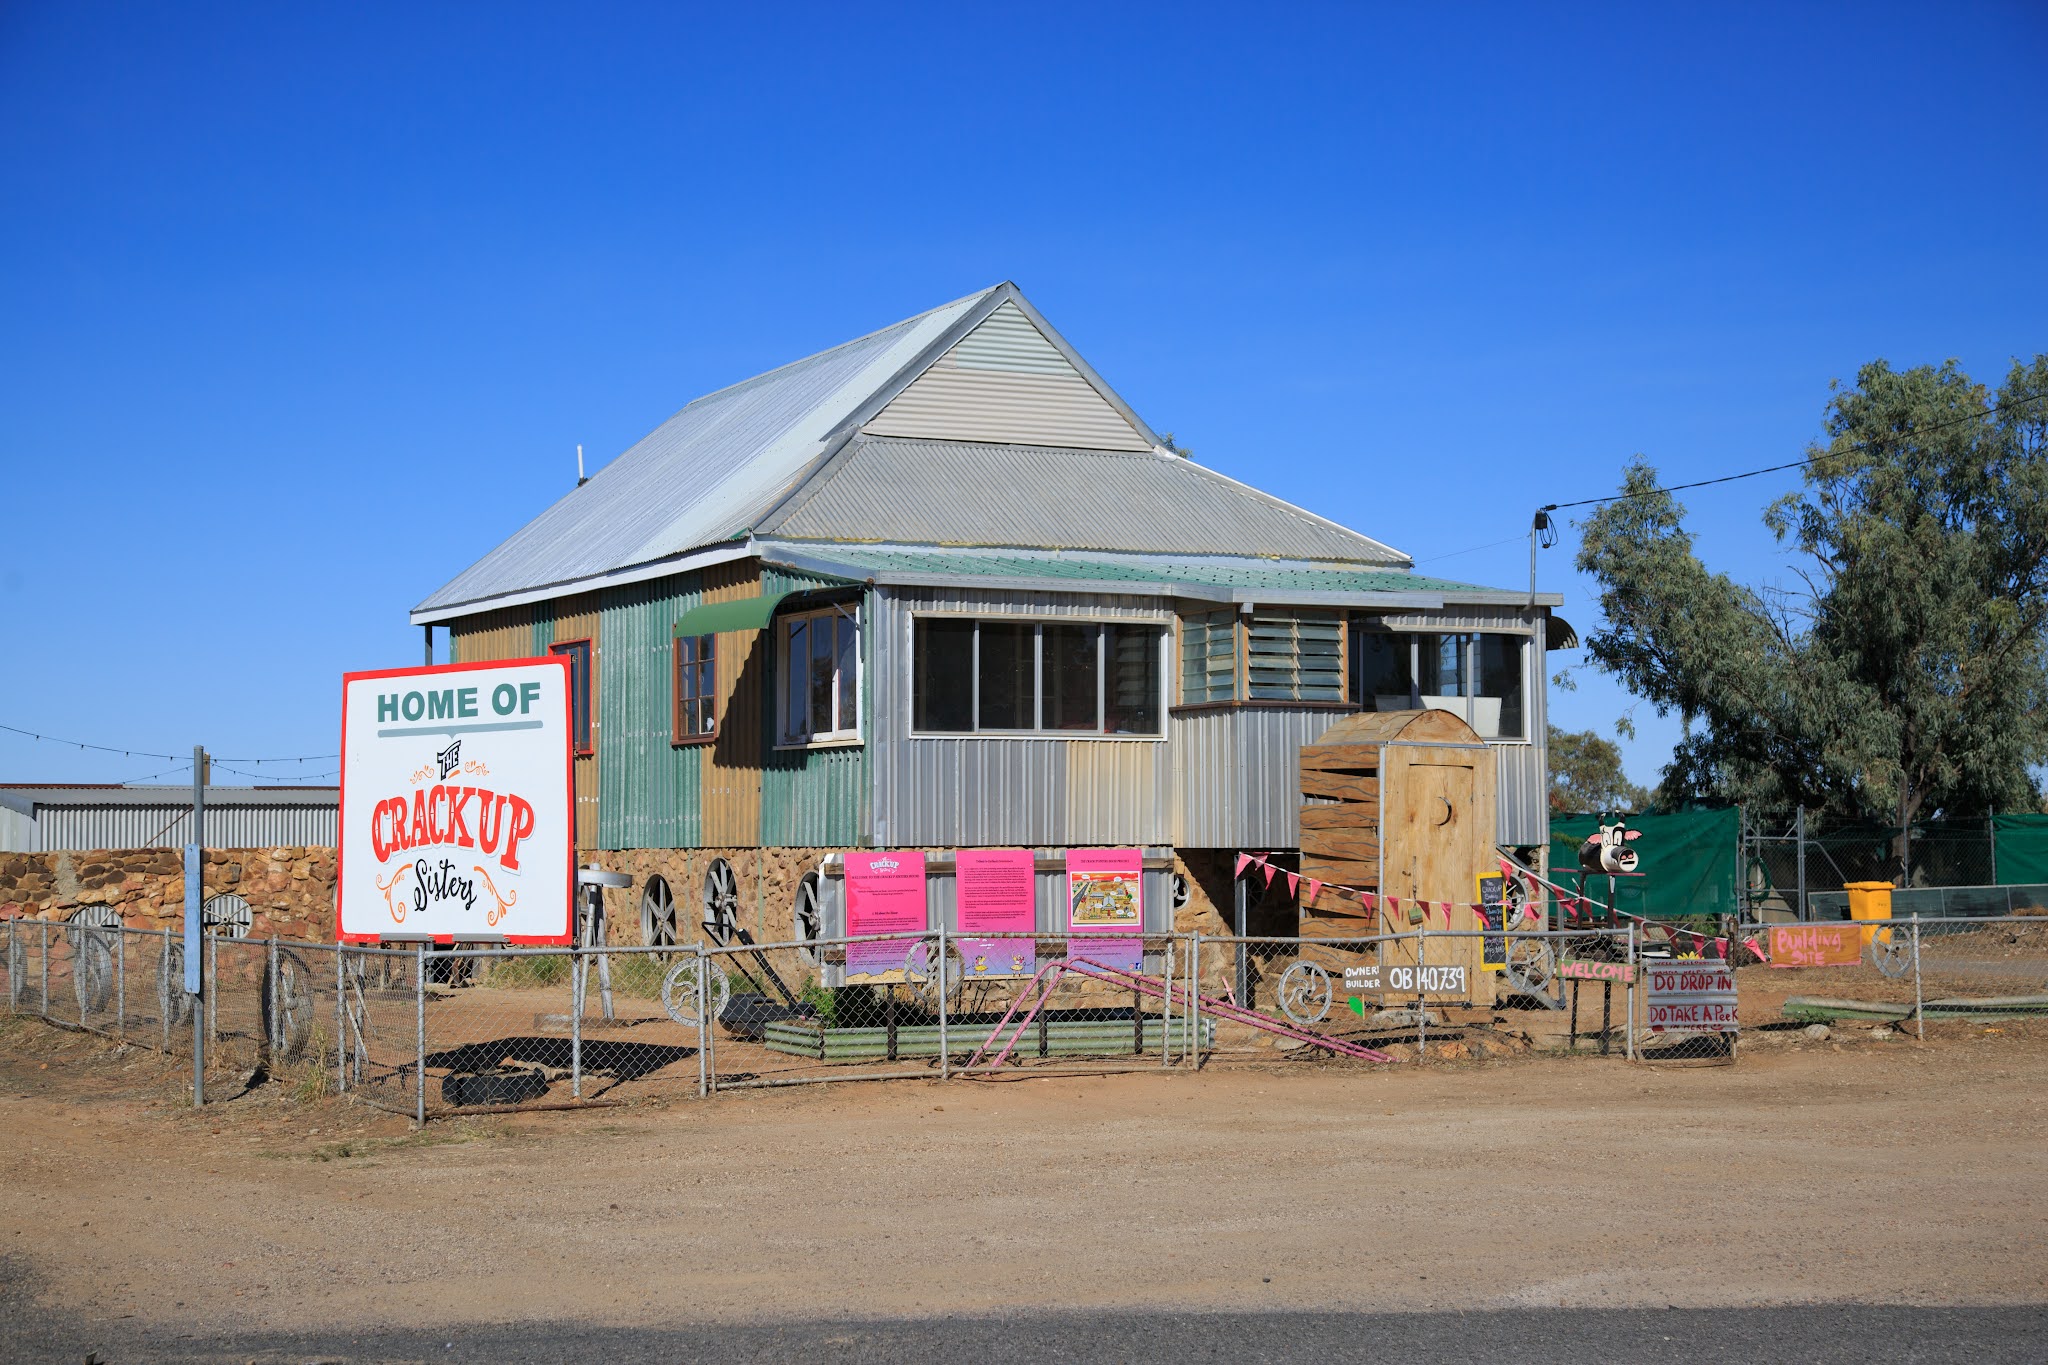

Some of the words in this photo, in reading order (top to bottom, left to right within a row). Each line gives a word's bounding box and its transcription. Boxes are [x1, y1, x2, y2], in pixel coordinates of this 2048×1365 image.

[377, 687, 478, 722] HOME
[492, 682, 540, 715] OF
[437, 740, 462, 781] THE
[371, 784, 535, 872] CRACKUP
[413, 858, 478, 912] Sisters
[1345, 978, 1381, 989] BUILDER
[1561, 961, 1635, 982] WELCOME
[1654, 975, 1675, 991] DO
[1681, 975, 1714, 991] DROP
[1717, 975, 1732, 991] IN
[1649, 1006, 1667, 1023] DO
[1667, 1005, 1699, 1022] TAKE
[1703, 1005, 1713, 1022] A
